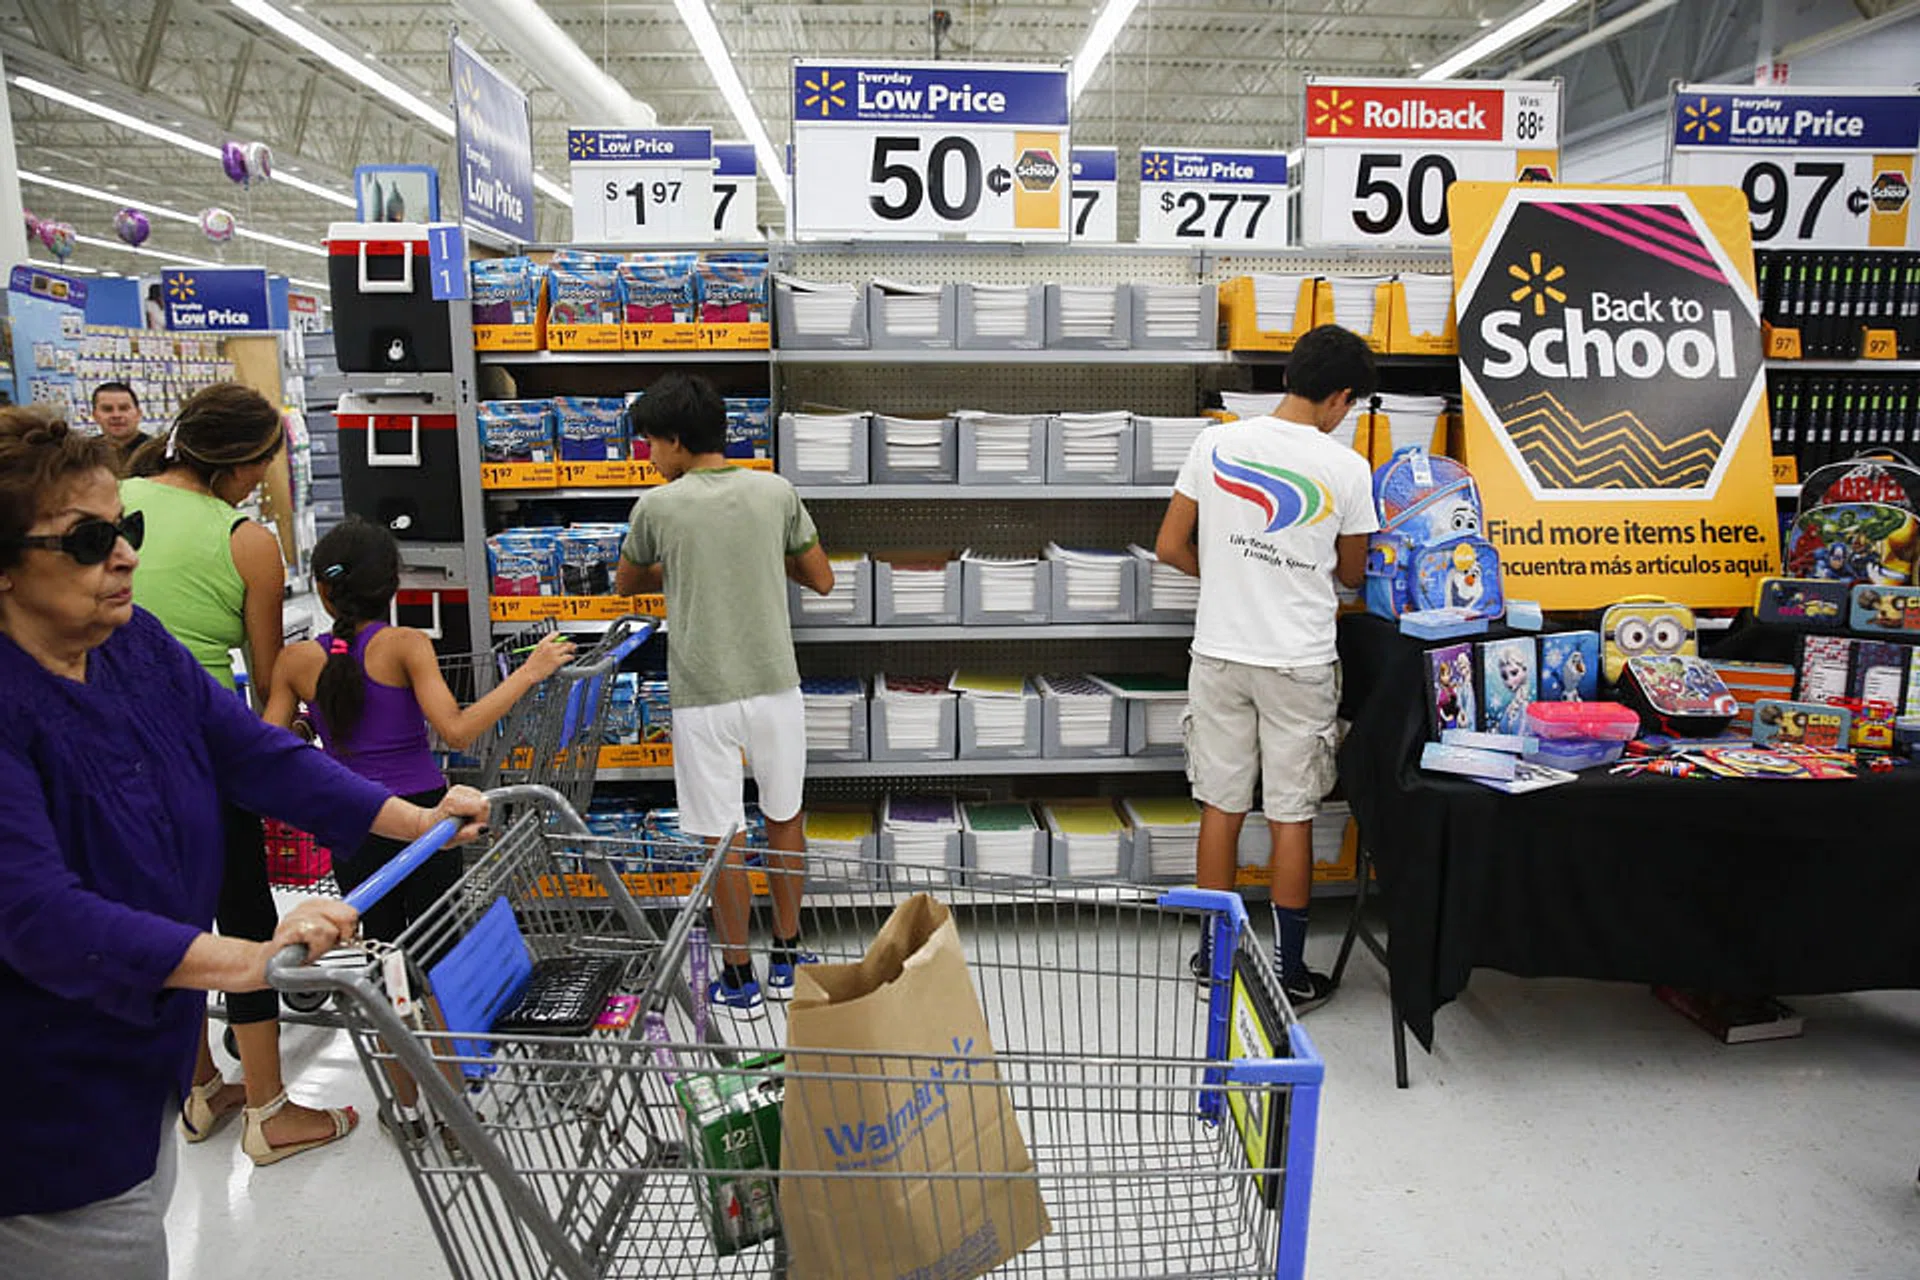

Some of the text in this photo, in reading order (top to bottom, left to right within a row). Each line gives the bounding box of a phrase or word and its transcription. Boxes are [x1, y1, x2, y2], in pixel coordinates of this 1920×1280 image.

[857, 71, 913, 86] Everyday
[857, 84, 1006, 113] Low Price
[1731, 98, 1783, 112] Everyday
[1363, 101, 1486, 131] Rollback
[1730, 109, 1865, 137] Low Price
[599, 138, 675, 154] Low Price
[1174, 160, 1255, 179] Low Price
[467, 163, 525, 224] Low Price
[172, 309, 249, 326] Low Price
[1591, 292, 1704, 324] Back to
[1480, 307, 1738, 380] School
[1487, 518, 1767, 546] Find more items here.
[1499, 552, 1775, 579] ncuentra más artículos aquí.
[823, 1066, 947, 1157] Walmart
